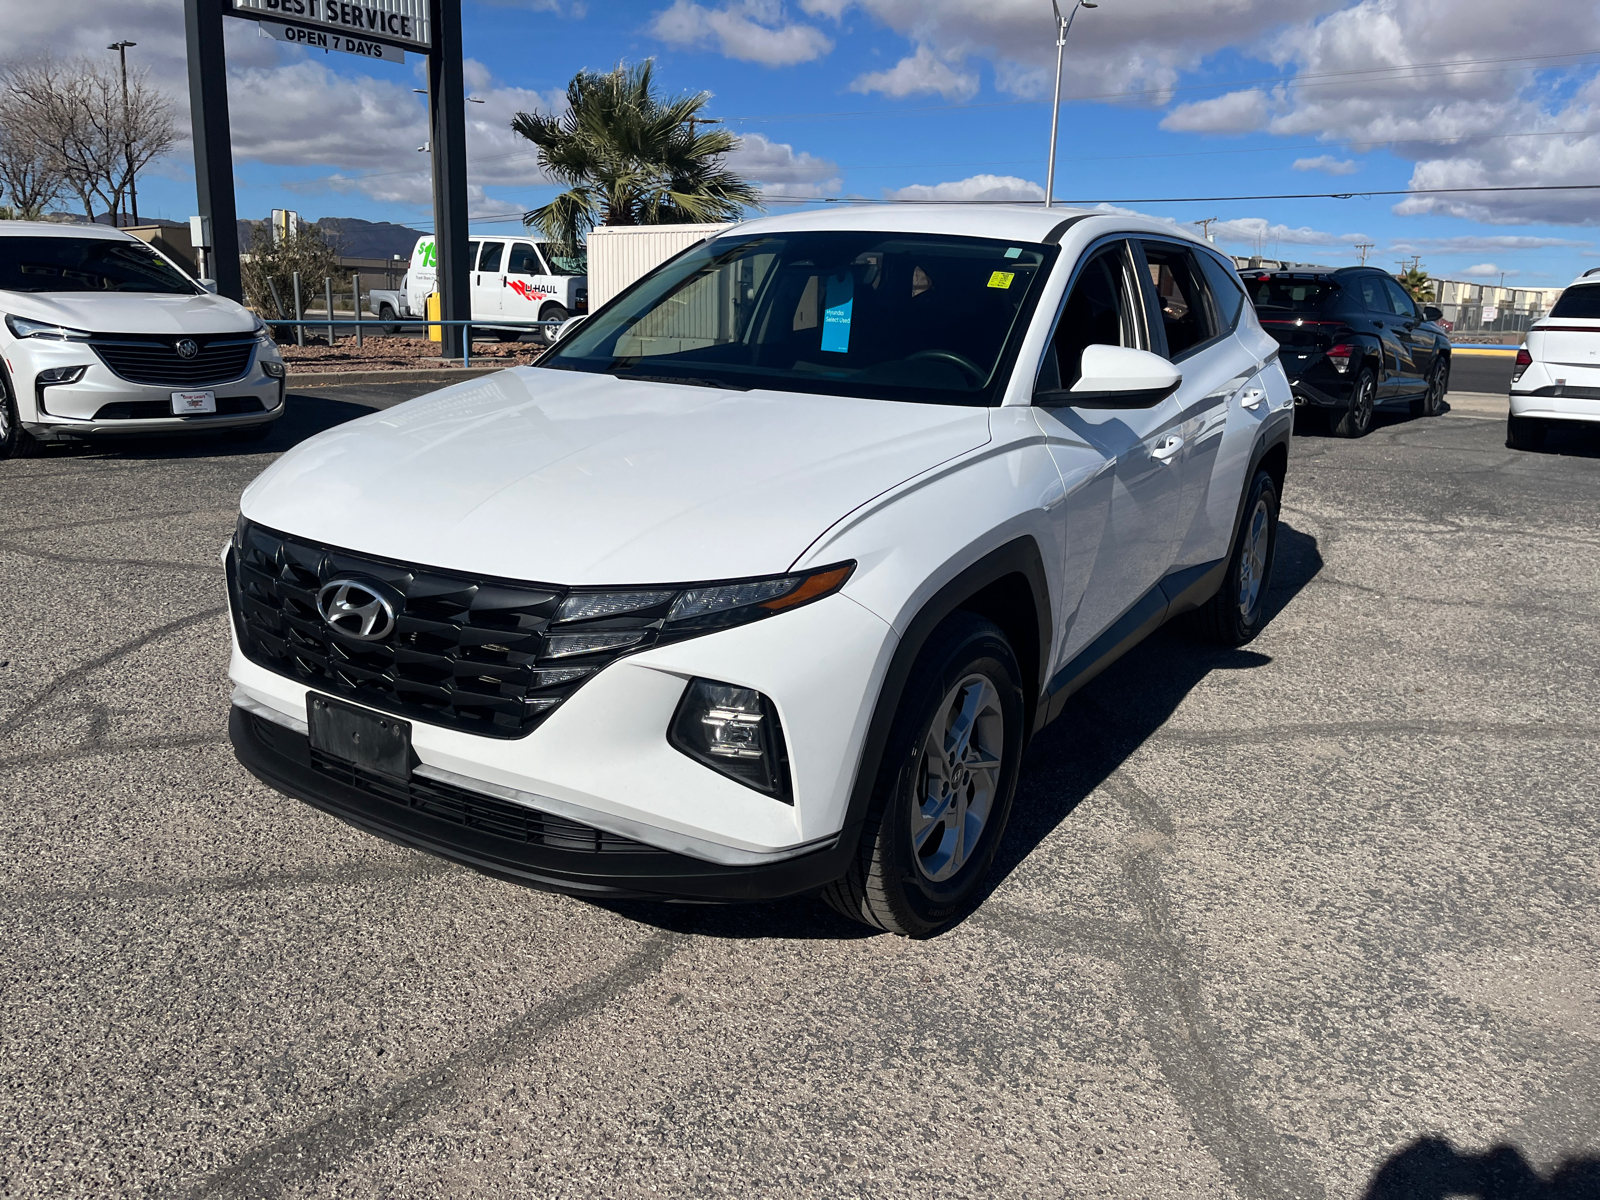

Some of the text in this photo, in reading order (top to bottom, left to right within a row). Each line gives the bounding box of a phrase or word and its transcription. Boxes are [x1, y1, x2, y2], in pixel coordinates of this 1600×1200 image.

[327, 1, 411, 37] SERVICE
[285, 27, 383, 58] OPEN 7 DAYS
[418, 241, 437, 267] $19
[525, 284, 558, 294] U-HAUL
